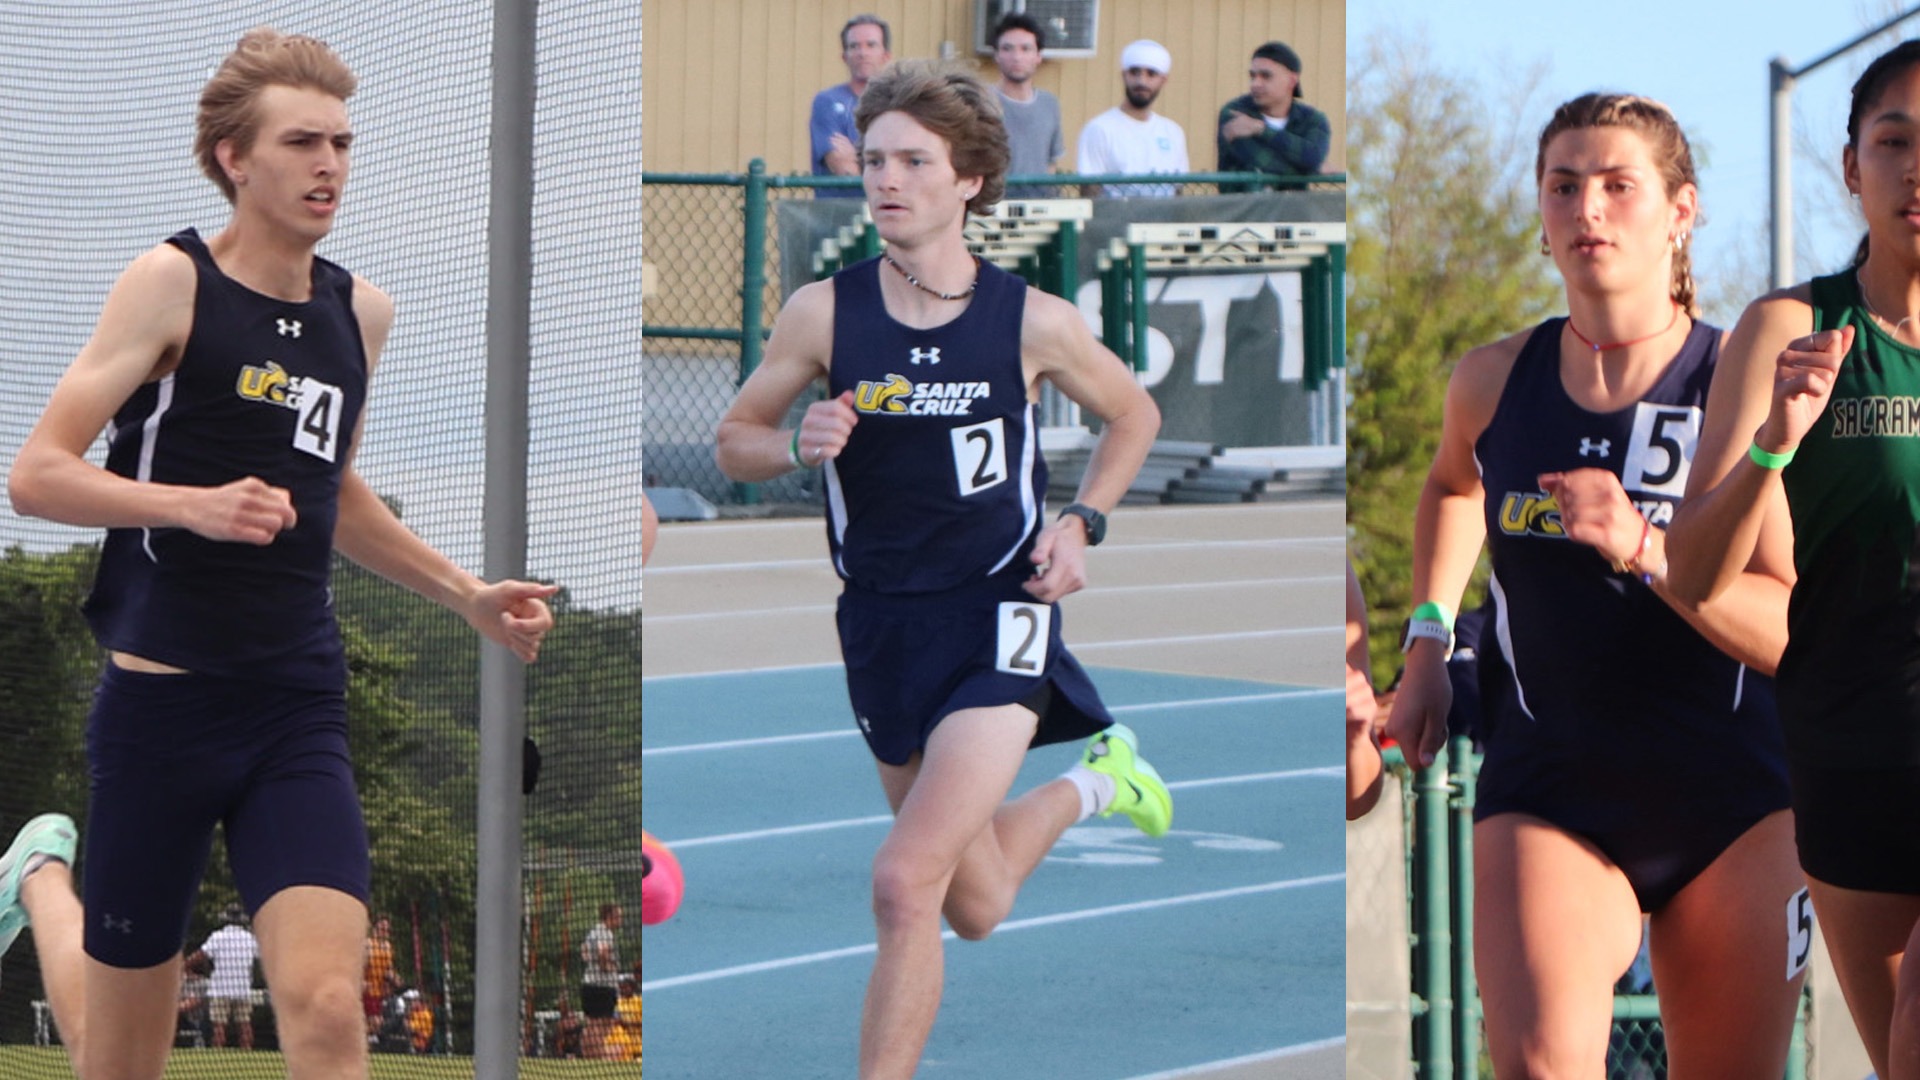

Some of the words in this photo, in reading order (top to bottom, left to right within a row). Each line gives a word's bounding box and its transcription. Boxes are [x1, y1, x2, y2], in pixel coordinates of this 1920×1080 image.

[909, 398, 973, 416] CRUZ
[912, 381, 990, 399] SANTA
[1831, 396, 1920, 438] SACRAM
[303, 390, 332, 452] 4
[1641, 411, 1689, 486] 5
[965, 428, 998, 489] 2
[1009, 606, 1039, 670] 2
[1796, 888, 1812, 968] 5
